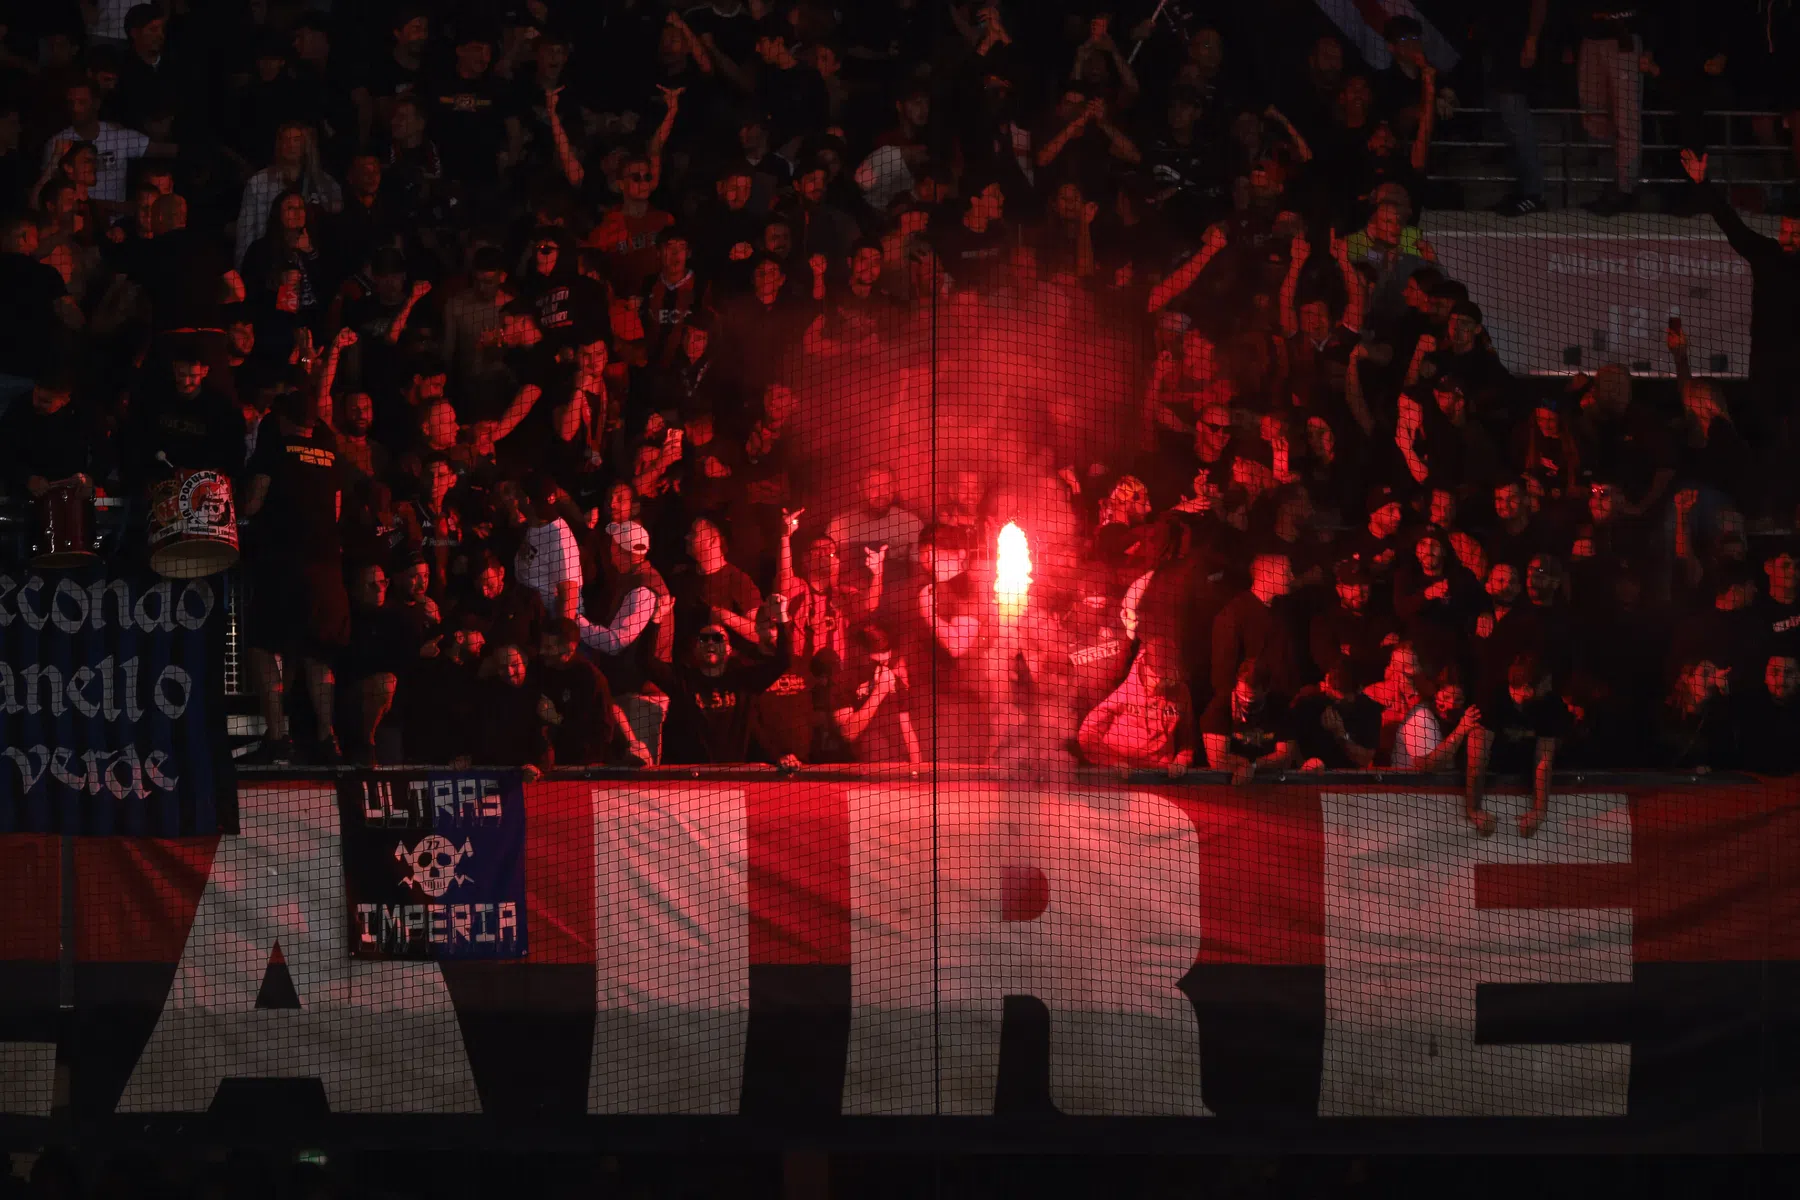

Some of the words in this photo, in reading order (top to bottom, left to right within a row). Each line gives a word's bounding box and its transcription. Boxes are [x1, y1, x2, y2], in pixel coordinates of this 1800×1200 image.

[0, 742, 181, 800] verde
[361, 778, 503, 821] ULTRAS
[356, 901, 519, 946] IMPERIA
[0, 787, 1634, 1118] AIRE
